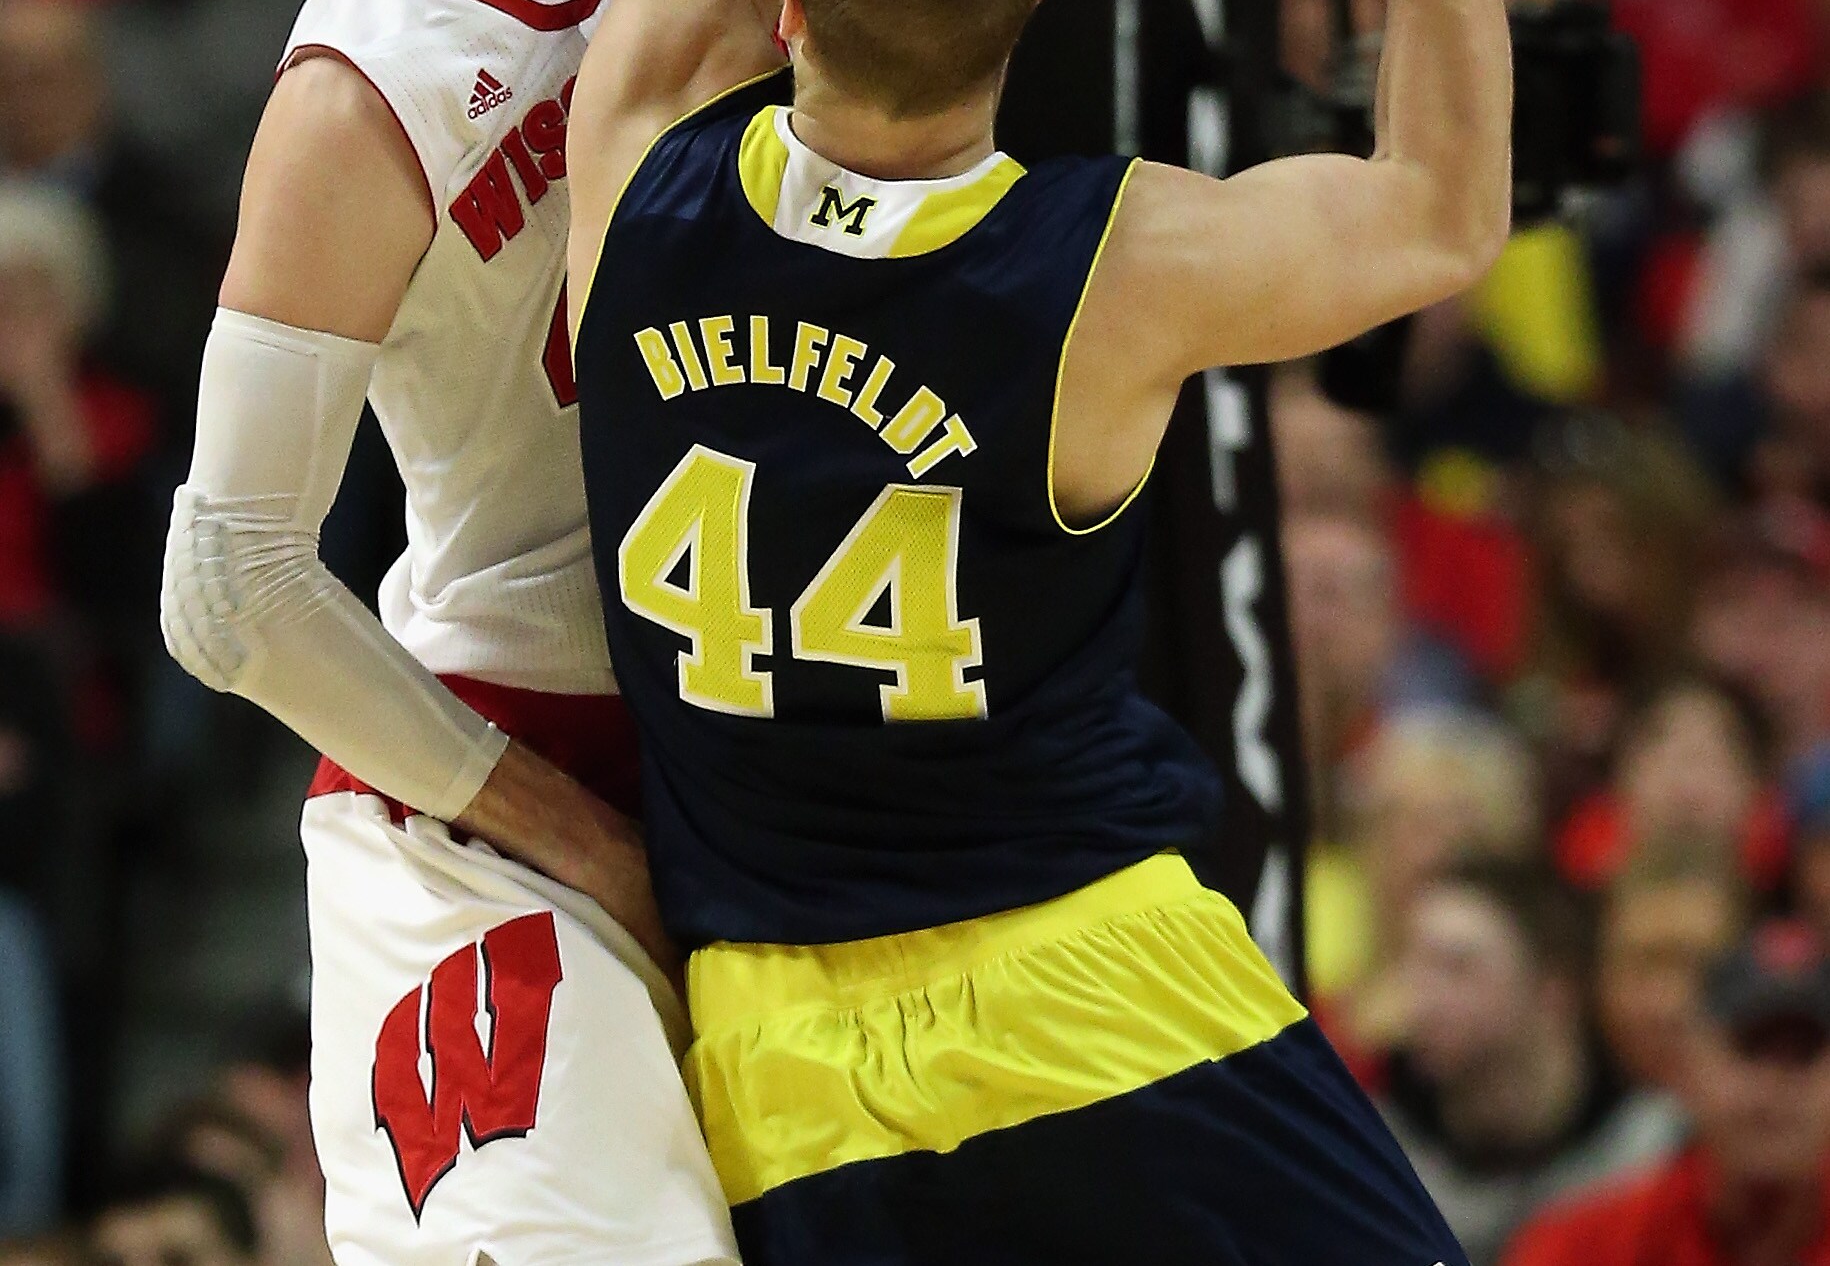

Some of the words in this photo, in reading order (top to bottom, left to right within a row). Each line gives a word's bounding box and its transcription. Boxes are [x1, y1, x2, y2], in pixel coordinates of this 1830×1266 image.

[449, 73, 578, 263] WIS
[467, 88, 513, 120] adidas
[808, 185, 877, 236] M
[633, 315, 977, 479] BIELFELDT
[617, 443, 989, 724] 44
[371, 909, 563, 1229] W
